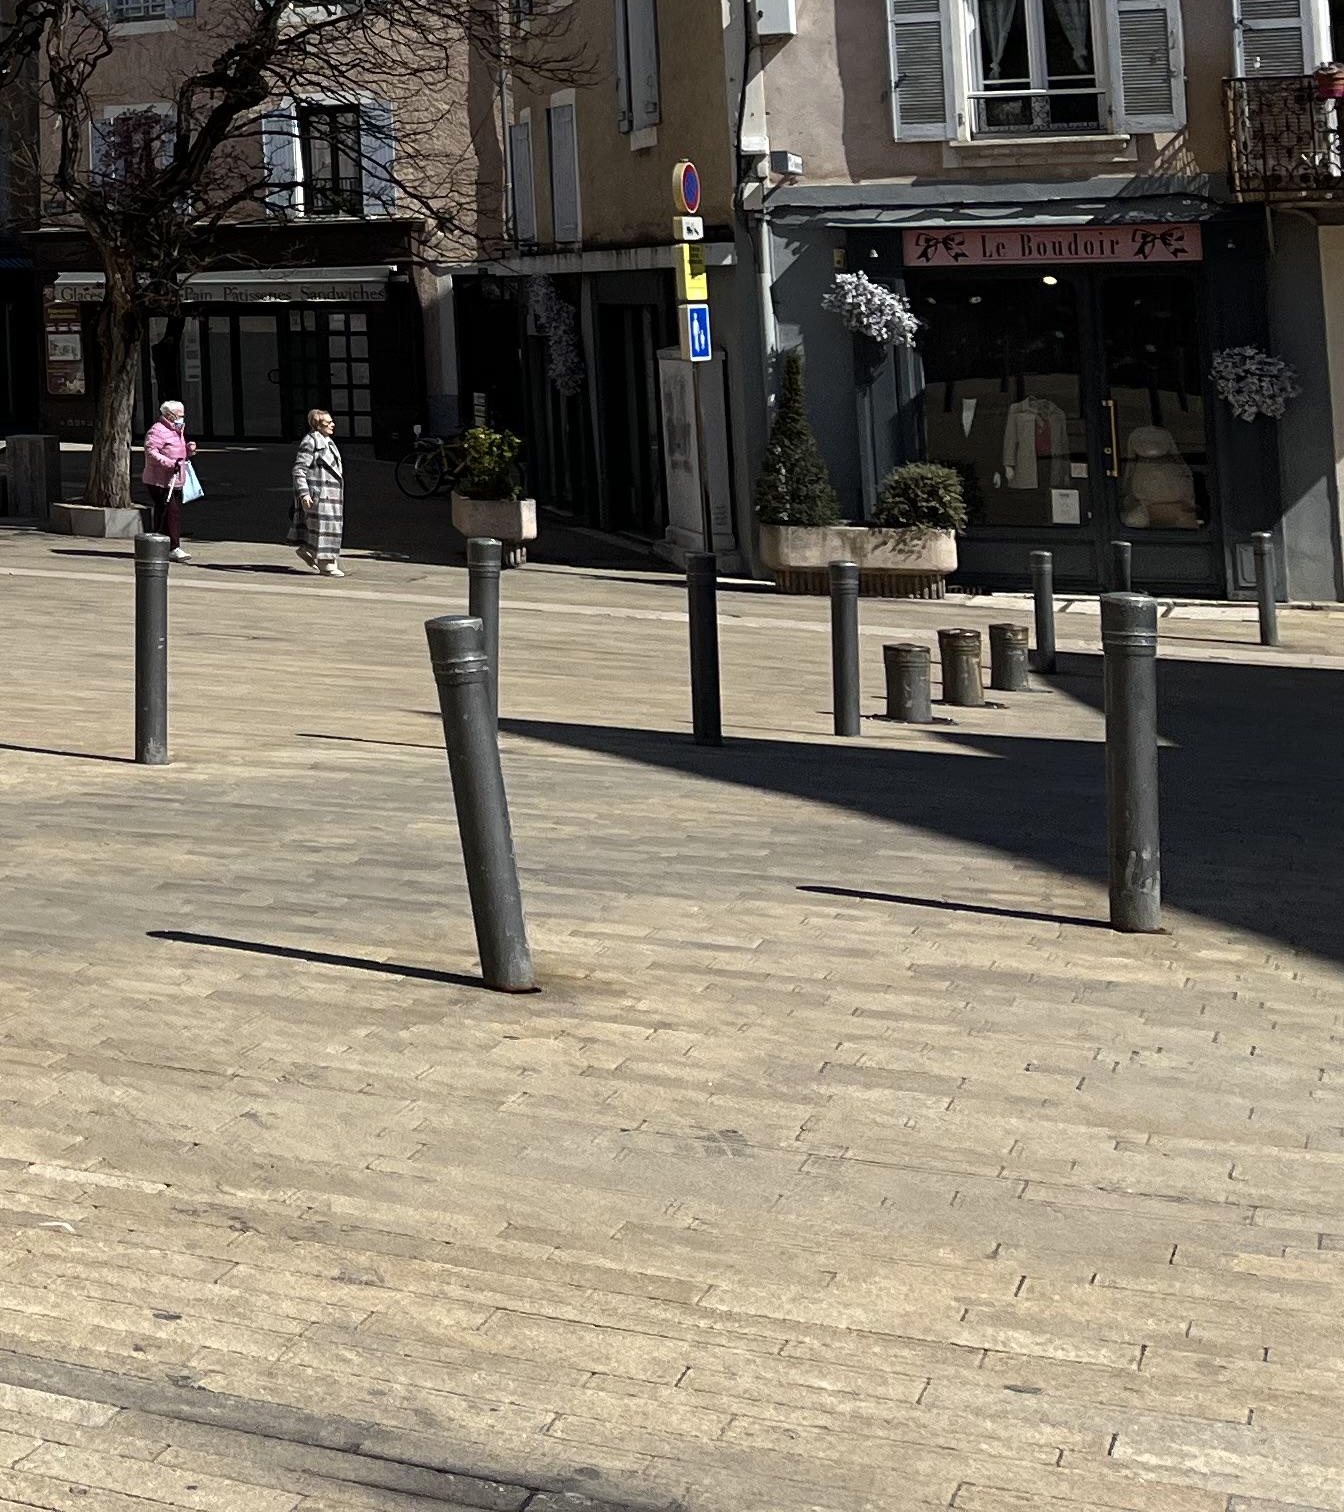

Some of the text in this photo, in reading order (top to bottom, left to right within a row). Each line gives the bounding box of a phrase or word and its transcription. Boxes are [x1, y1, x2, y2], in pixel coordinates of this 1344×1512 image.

[981, 231, 1119, 258] Le Boudoir
[300, 284, 385, 301] Sandwiches
